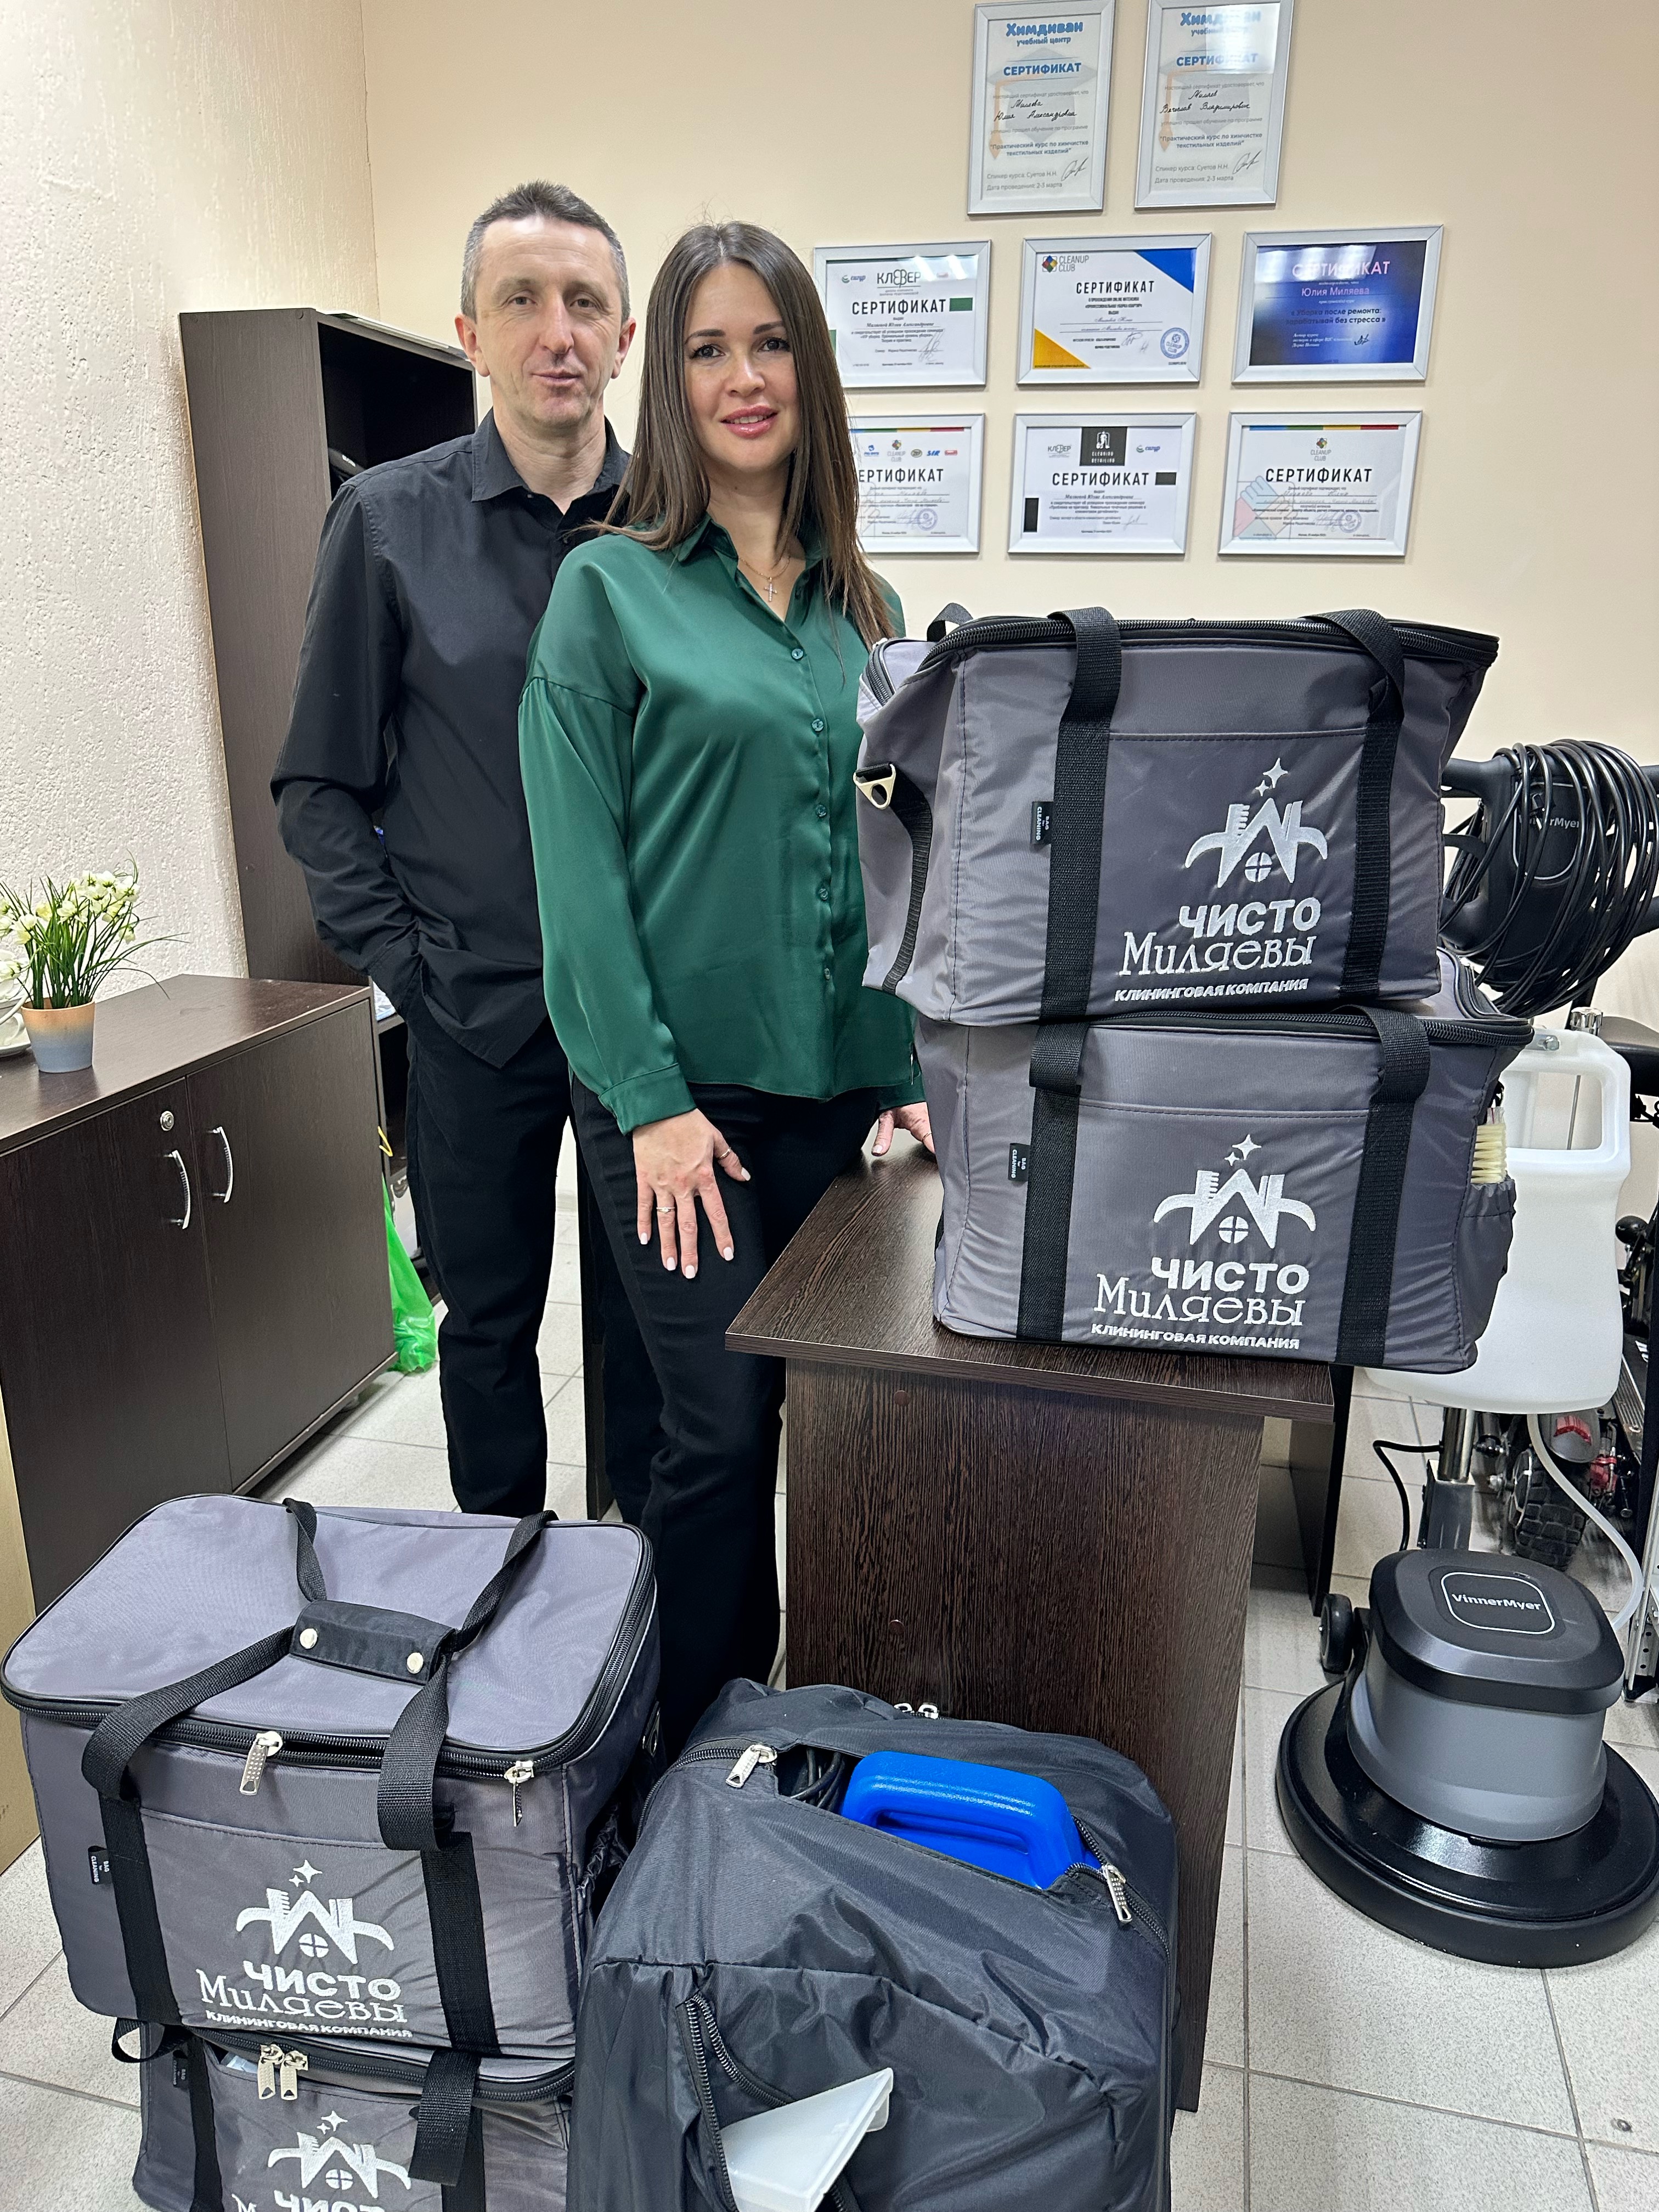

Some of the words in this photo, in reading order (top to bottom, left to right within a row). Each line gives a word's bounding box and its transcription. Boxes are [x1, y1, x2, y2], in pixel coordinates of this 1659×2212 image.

[1006, 22, 1083, 37] Химдиван
[1017, 37, 1048, 46] учебный
[1049, 36, 1071, 44] центр
[1003, 63, 1081, 76] СЕРТИФИКАТ
[1059, 255, 1089, 264] CLEANUP
[1059, 263, 1075, 272] CLUB
[1076, 281, 1154, 294] СЕРТИФИКАТ
[1301, 287, 1327, 296] Юлия
[1330, 287, 1369, 296] Миляева
[852, 300, 946, 315] СЕРТИФИКАТ
[859, 469, 944, 483] ЕРТИФИКАТ
[1052, 472, 1149, 486] СЕРТИФИКАТ
[1266, 467, 1372, 483] СЕРТИФИКАТ
[1178, 897, 1321, 938] ЧИСТО
[1115, 932, 1317, 975] Миляевы
[1115, 984, 1226, 1002] КЛИНИНГОВАЯ
[1226, 979, 1309, 996] КОМПАНИЯ
[1152, 1257, 1310, 1295] ЧИСТО
[1093, 1272, 1306, 1327] Миляевы
[1091, 1323, 1206, 1345] КЛИНИНГОВАЯ
[1207, 1335, 1300, 1350] КОМПАНИЯ
[1452, 1594, 1541, 1611] VinnerMyer
[91, 1856, 99, 1882] CLEANING
[243, 1960, 402, 2001] ЧИСТО
[195, 1968, 408, 2023] Миляевы
[206, 2009, 318, 2033] КЛИНИНГОВАЯ
[320, 2023, 413, 2038] КОМПАНИЯ
